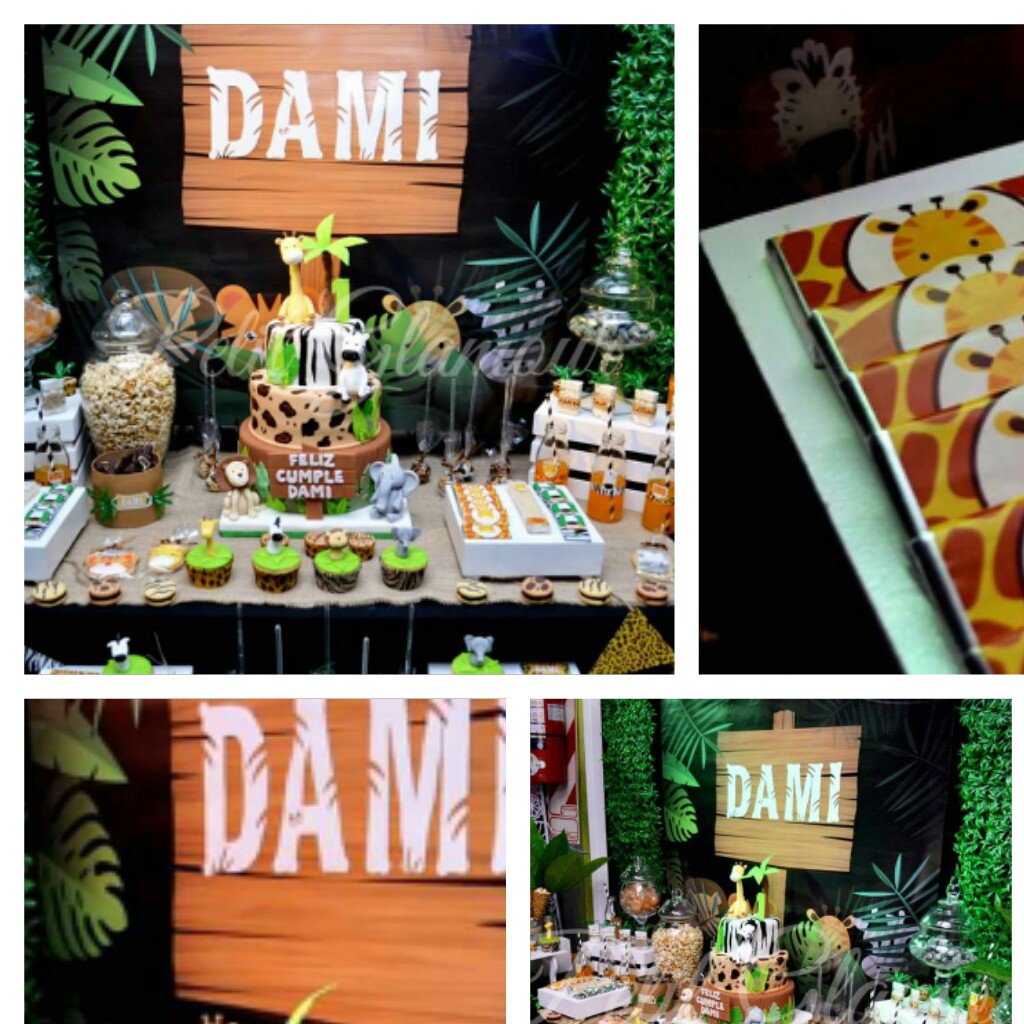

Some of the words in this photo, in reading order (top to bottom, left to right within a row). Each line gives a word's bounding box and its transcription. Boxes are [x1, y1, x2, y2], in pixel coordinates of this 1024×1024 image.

[207, 66, 442, 162] DAMI
[288, 453, 336, 468] FELIZ
[276, 469, 345, 484] CUMPLE
[287, 485, 333, 499] DAMI
[725, 760, 842, 823] DAMI
